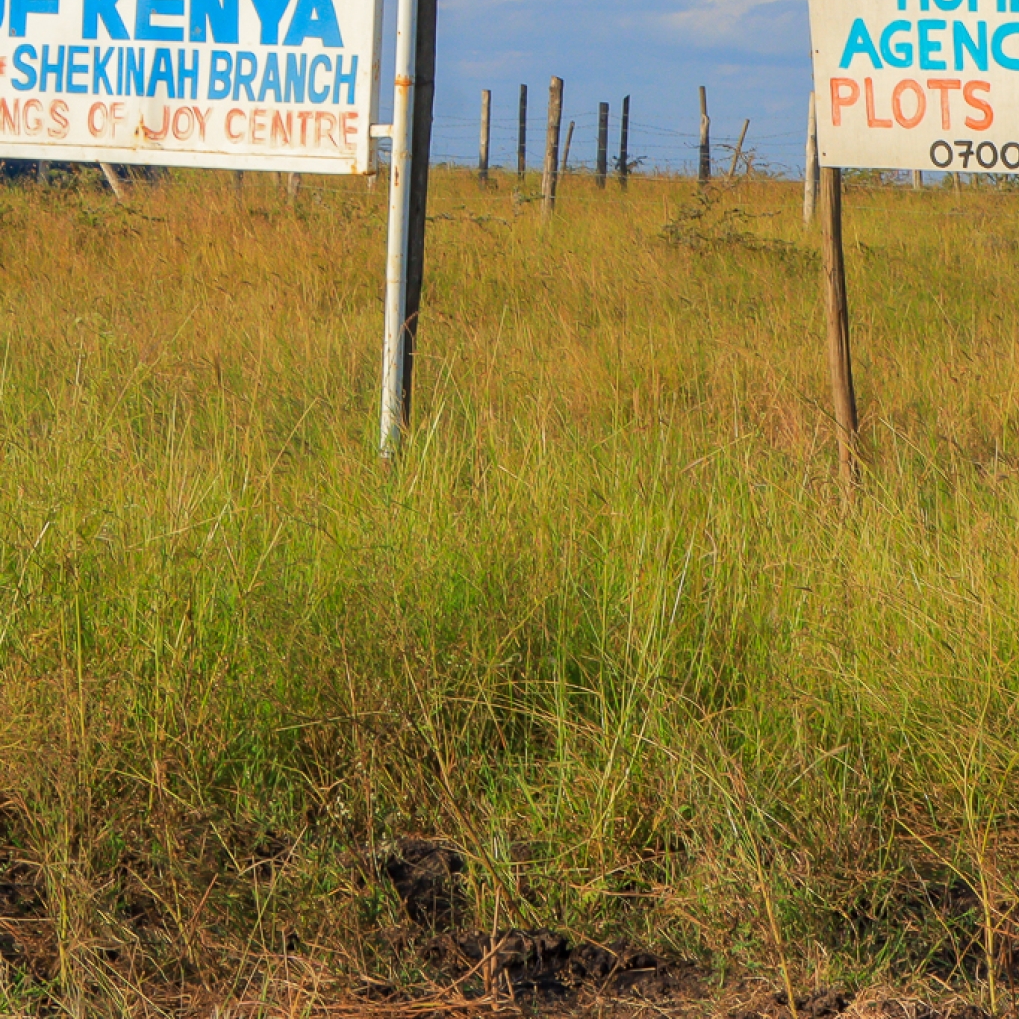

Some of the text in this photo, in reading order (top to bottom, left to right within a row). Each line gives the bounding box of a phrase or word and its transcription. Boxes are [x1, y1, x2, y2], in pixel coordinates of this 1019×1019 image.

[10, 43, 359, 106] SHEKINAH BRANCH
[87, 101, 126, 139] OF
[141, 103, 214, 143] JOY
[223, 108, 361, 151] CENTRE
[829, 77, 994, 131] PLOTS
